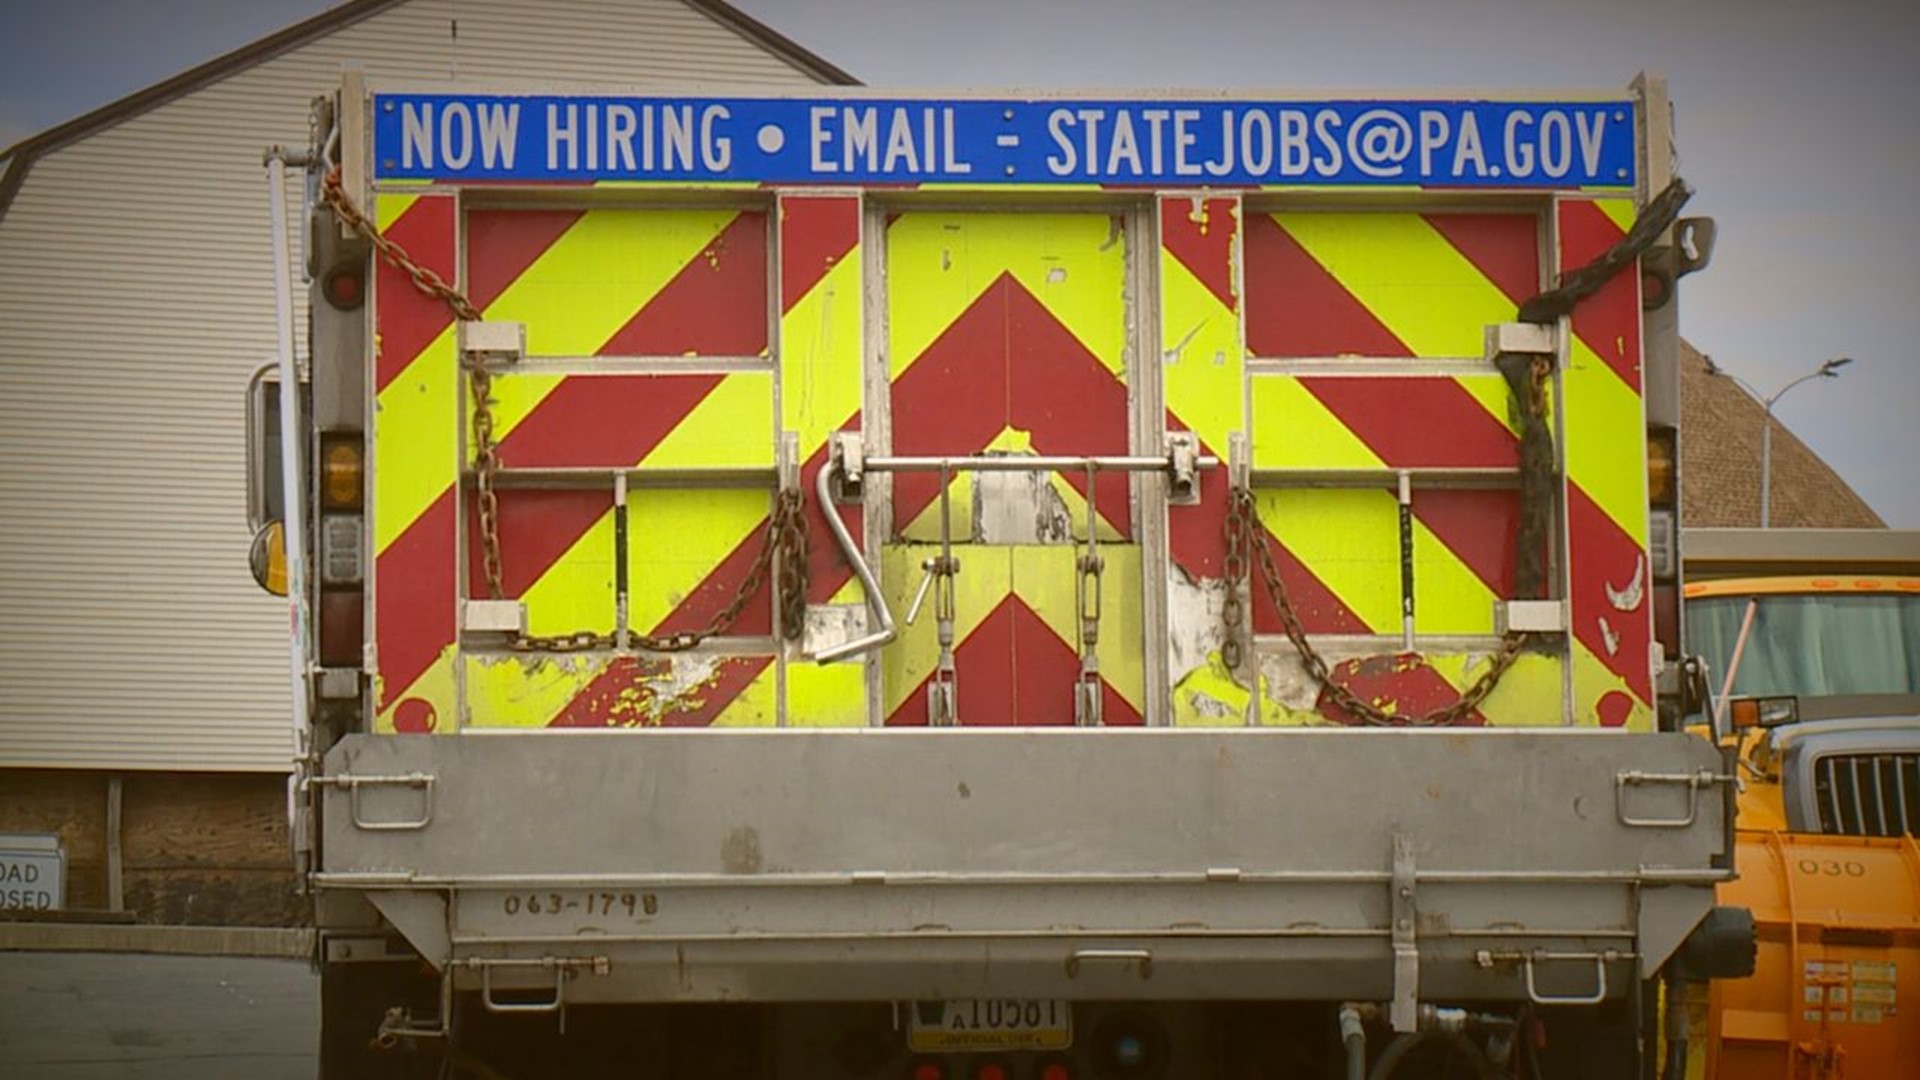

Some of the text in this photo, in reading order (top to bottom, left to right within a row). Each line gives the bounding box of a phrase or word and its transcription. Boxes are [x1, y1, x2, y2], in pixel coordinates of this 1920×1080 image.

[402, 103, 519, 170] NOW
[547, 104, 732, 172] HIRING
[809, 107, 971, 173] EMAIL
[1047, 107, 1607, 178] STATEJOBS@PA.GOV
